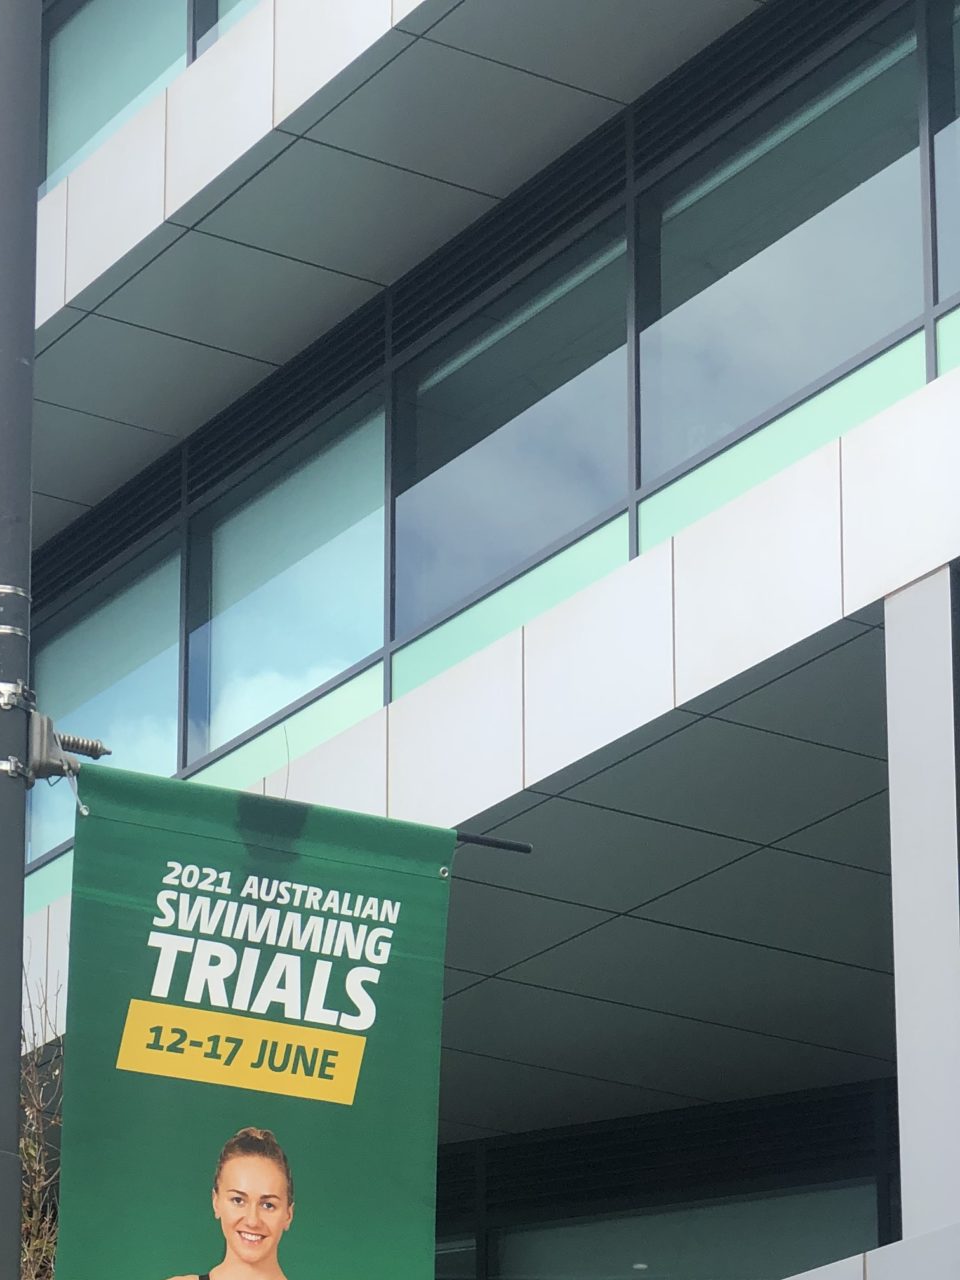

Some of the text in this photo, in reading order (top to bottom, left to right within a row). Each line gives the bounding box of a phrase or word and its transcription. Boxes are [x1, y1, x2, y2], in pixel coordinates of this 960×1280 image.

[162, 861, 401, 924] 2021 AUSTRALIAN
[153, 890, 394, 964] SWIMMING
[147, 931, 381, 1031] TRIALS
[146, 1025, 339, 1080] 12-17 JUNE
